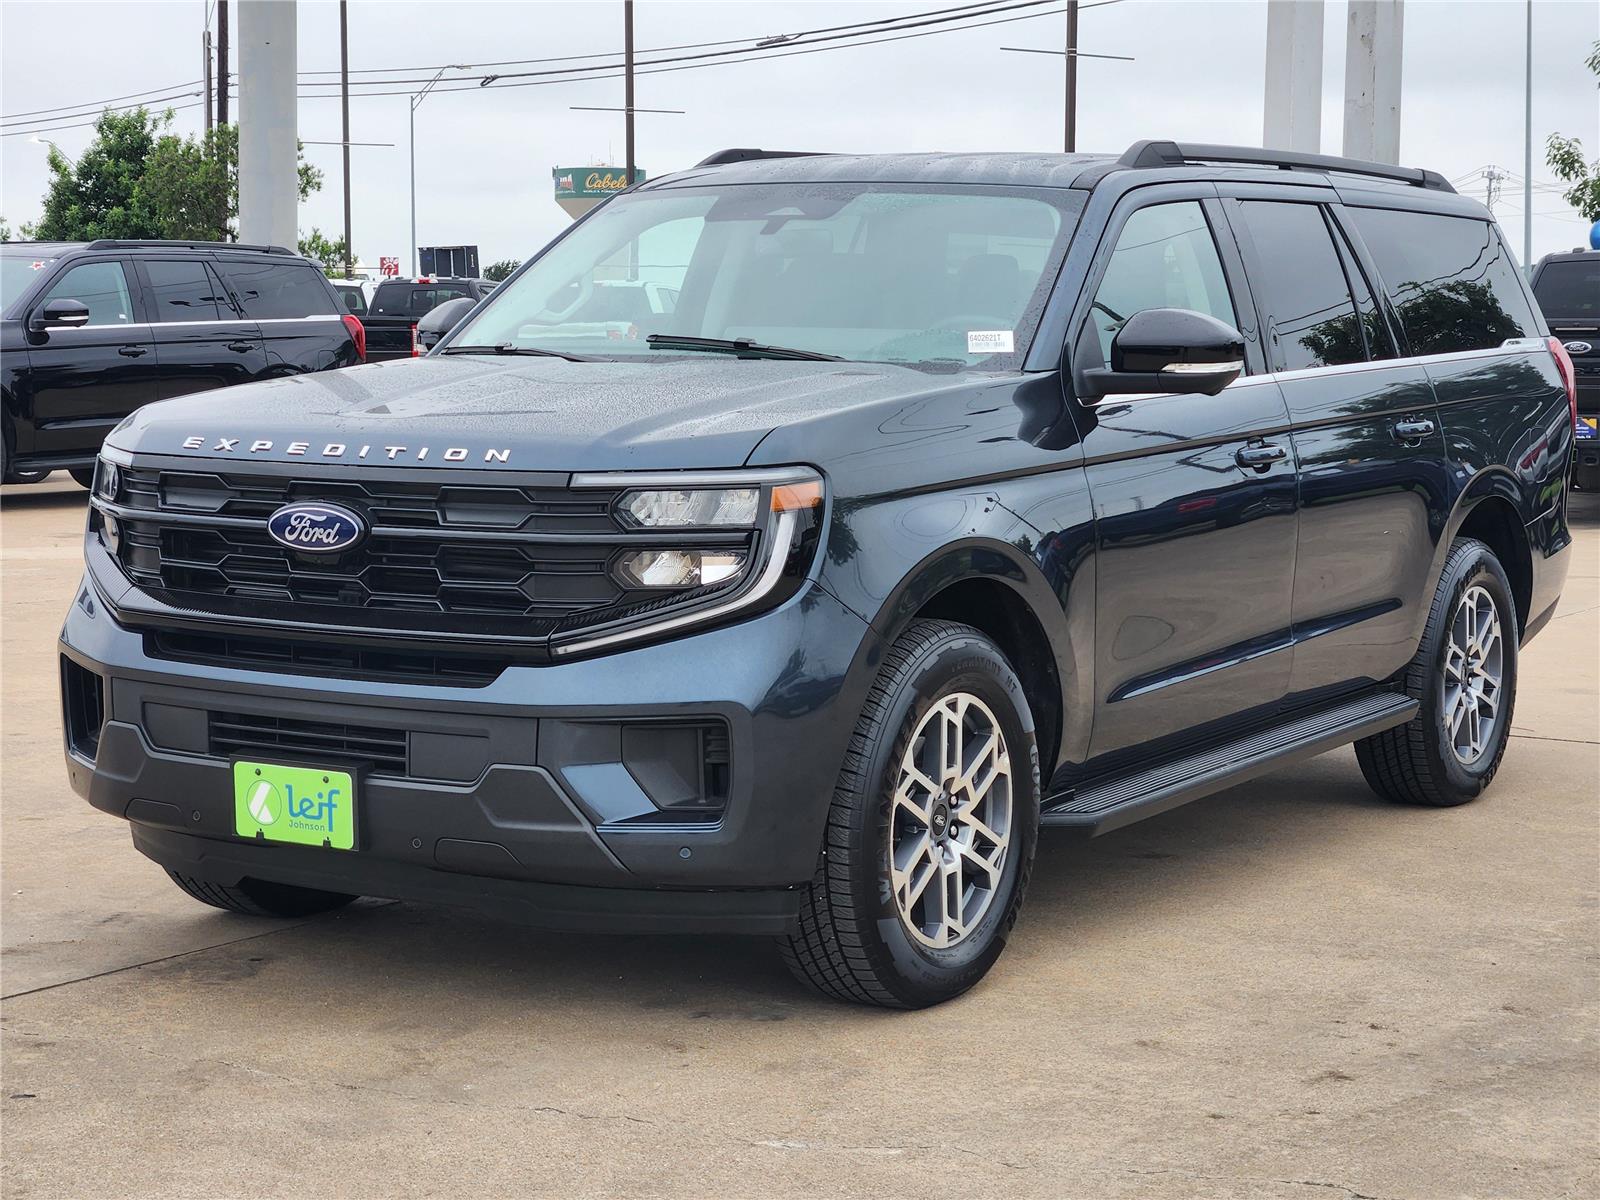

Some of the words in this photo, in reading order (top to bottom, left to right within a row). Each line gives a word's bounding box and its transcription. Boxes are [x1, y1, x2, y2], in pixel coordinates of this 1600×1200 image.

[1569, 343, 1586, 351] Ford
[182, 436, 511, 463] EXPEDITION
[285, 512, 342, 545] Ford
[288, 820, 325, 832] Johnson
